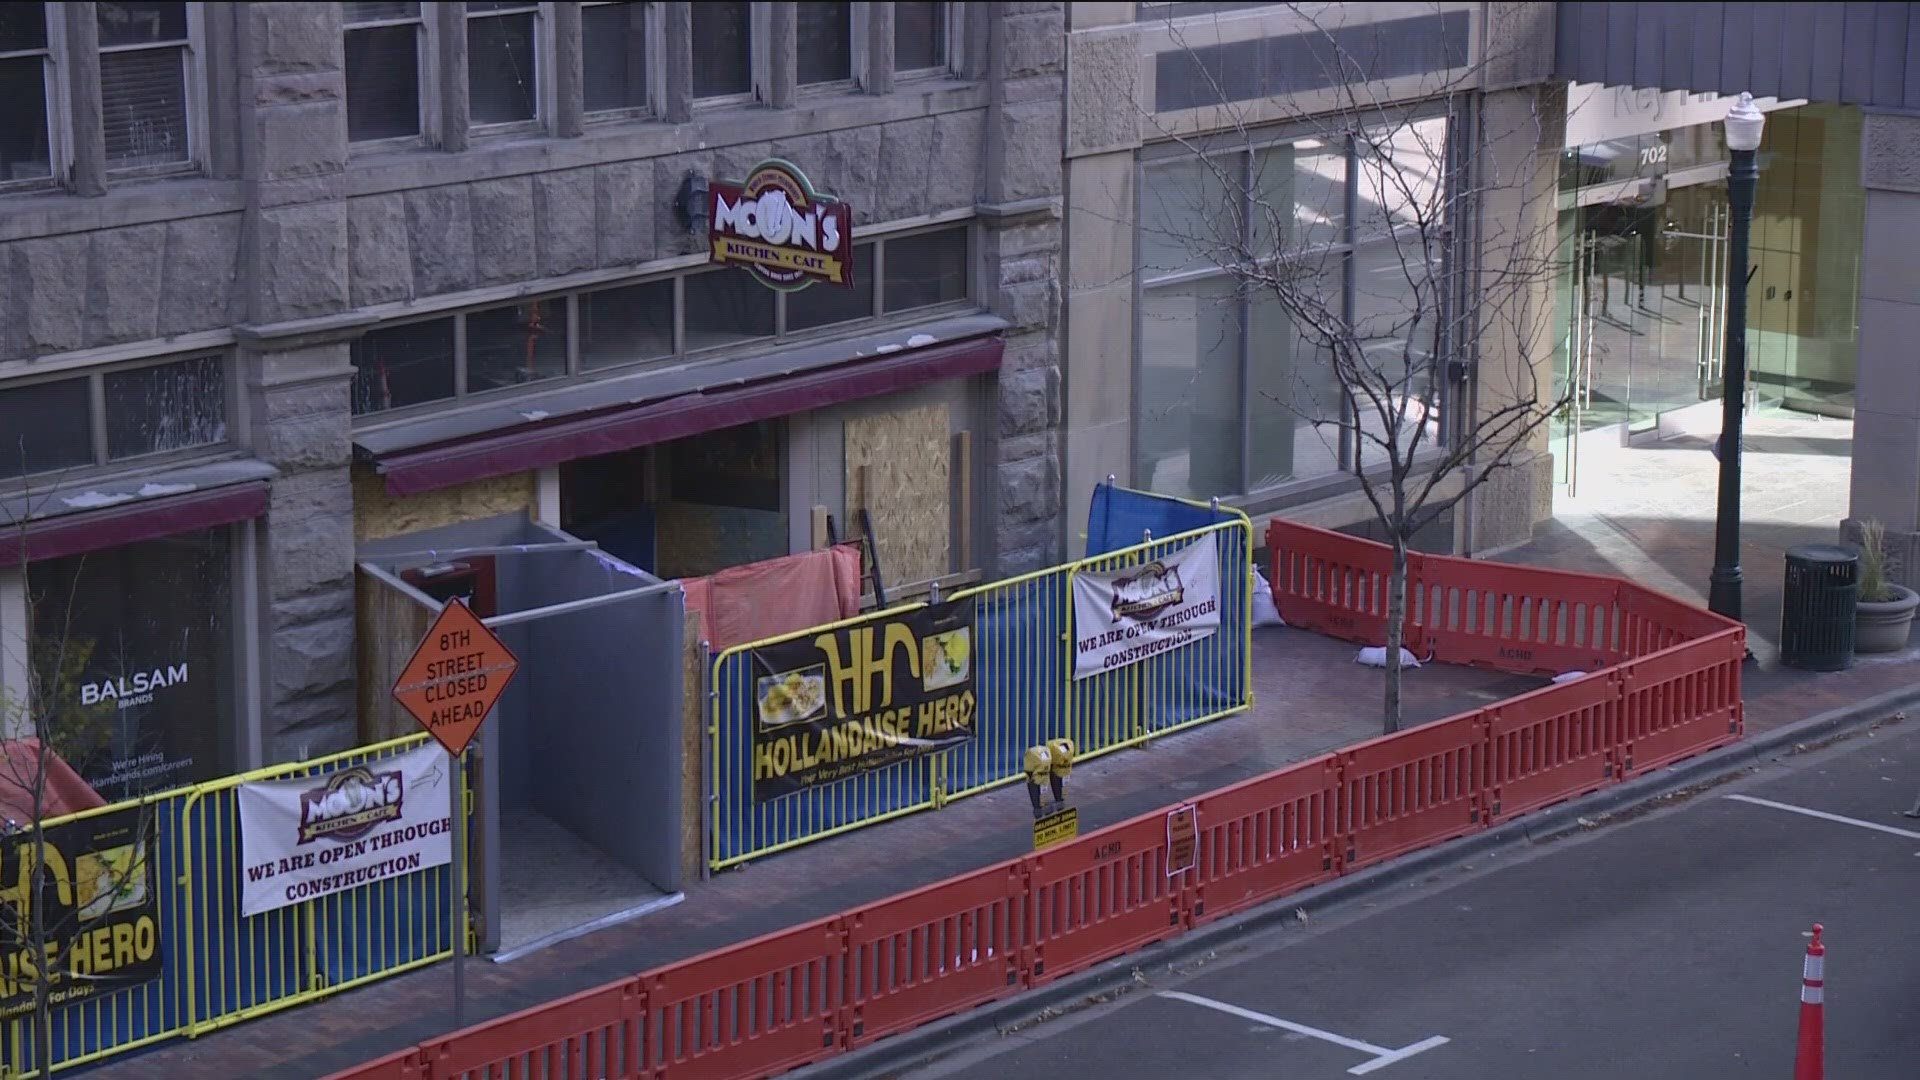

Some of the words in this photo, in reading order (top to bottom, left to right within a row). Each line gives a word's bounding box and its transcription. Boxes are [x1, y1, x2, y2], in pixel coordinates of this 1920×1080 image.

[1641, 145, 1667, 165] 702
[727, 241, 780, 261] KITCHEN
[440, 630, 470, 650] 8TH
[1078, 636, 1097, 654] WE
[1099, 629, 1124, 648] ARE
[1126, 620, 1158, 639] OPEN
[1160, 599, 1217, 628] THROUGH
[1103, 628, 1193, 669] CONSTRUCTION
[427, 652, 484, 680] STREET
[81, 663, 188, 705] BALSAM
[425, 674, 487, 703] CLOSED
[118, 693, 153, 708] BRANDS
[430, 700, 484, 728] AHEAD
[755, 706, 912, 780] HOLLANDAISE
[916, 690, 975, 737] HERO
[138, 752, 164, 765] Hiring
[248, 862, 275, 883] WE
[278, 852, 315, 875] ARE
[319, 842, 366, 865] OPEN
[369, 817, 451, 851] THROUGH
[285, 852, 421, 900] CONSTRUCTION
[70, 915, 155, 979] HERO
[49, 991, 66, 1004] For
[68, 984, 95, 998] Days
